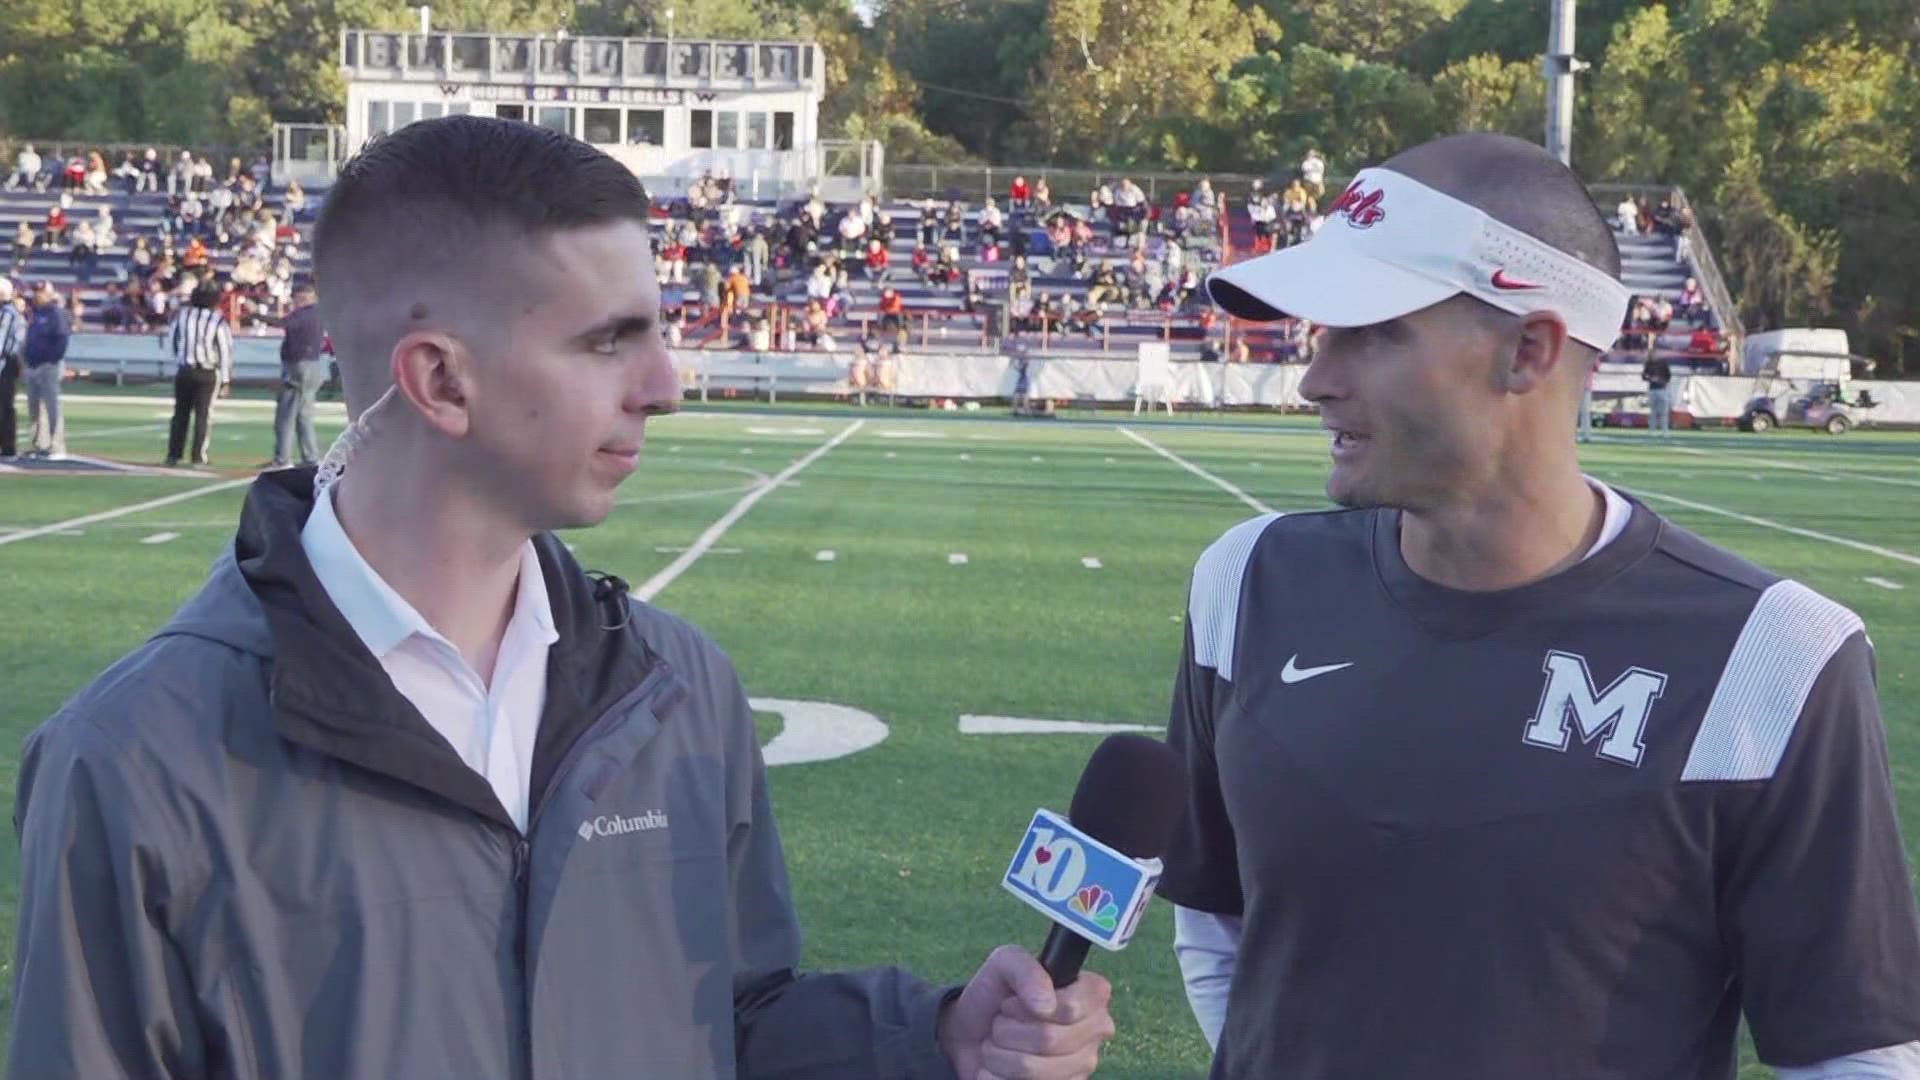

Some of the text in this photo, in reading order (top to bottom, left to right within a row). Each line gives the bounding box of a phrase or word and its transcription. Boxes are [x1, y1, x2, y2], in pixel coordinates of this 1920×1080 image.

[671, 44, 793, 80] FIELD
[1522, 649, 1668, 768] M
[594, 809, 669, 836] Columbia
[1010, 827, 1087, 902] 10
